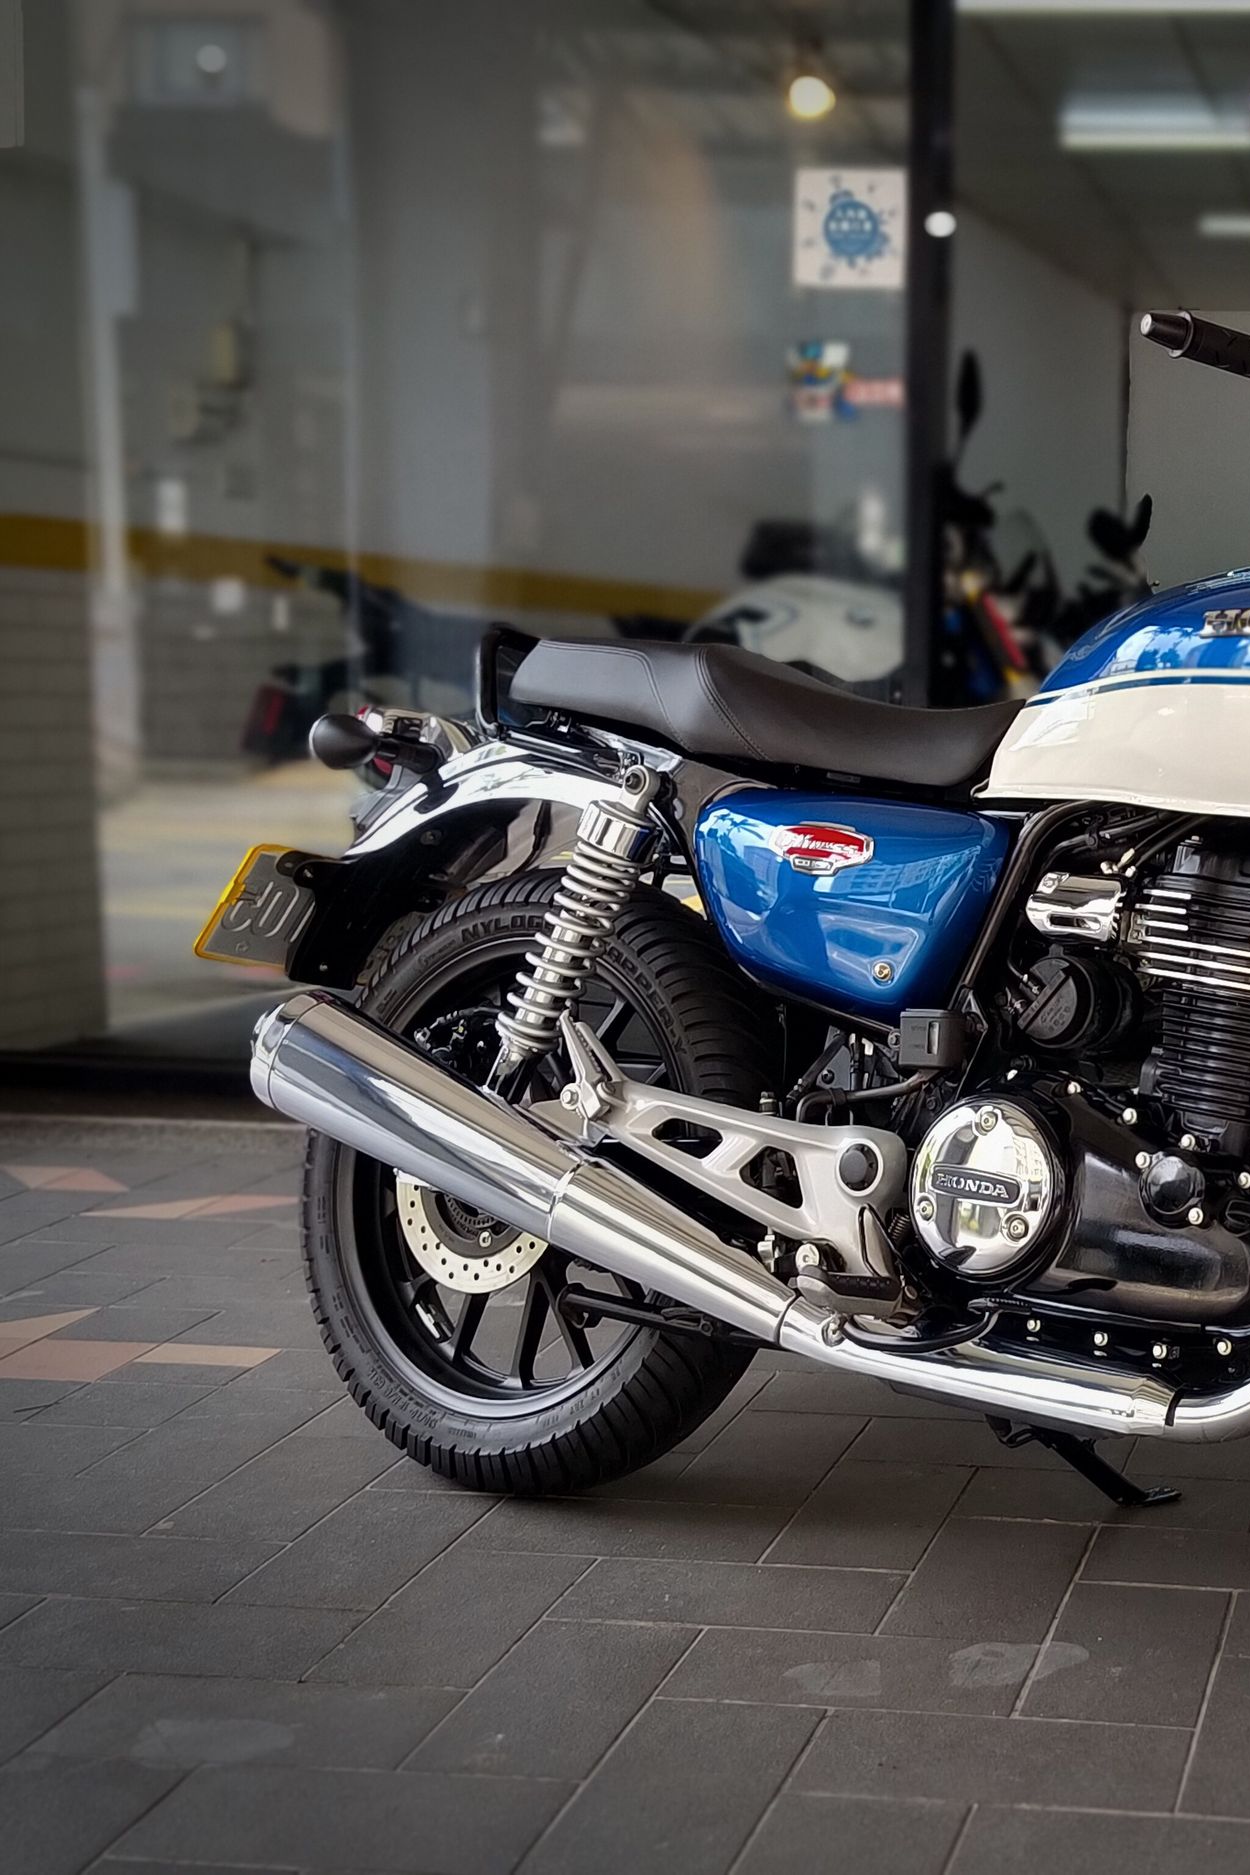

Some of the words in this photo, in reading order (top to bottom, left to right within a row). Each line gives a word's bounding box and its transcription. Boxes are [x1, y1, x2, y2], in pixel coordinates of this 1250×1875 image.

[460, 913, 552, 942] NYLOG
[603, 941, 688, 1055] APPER-Y
[935, 1173, 1009, 1199] HONDA
